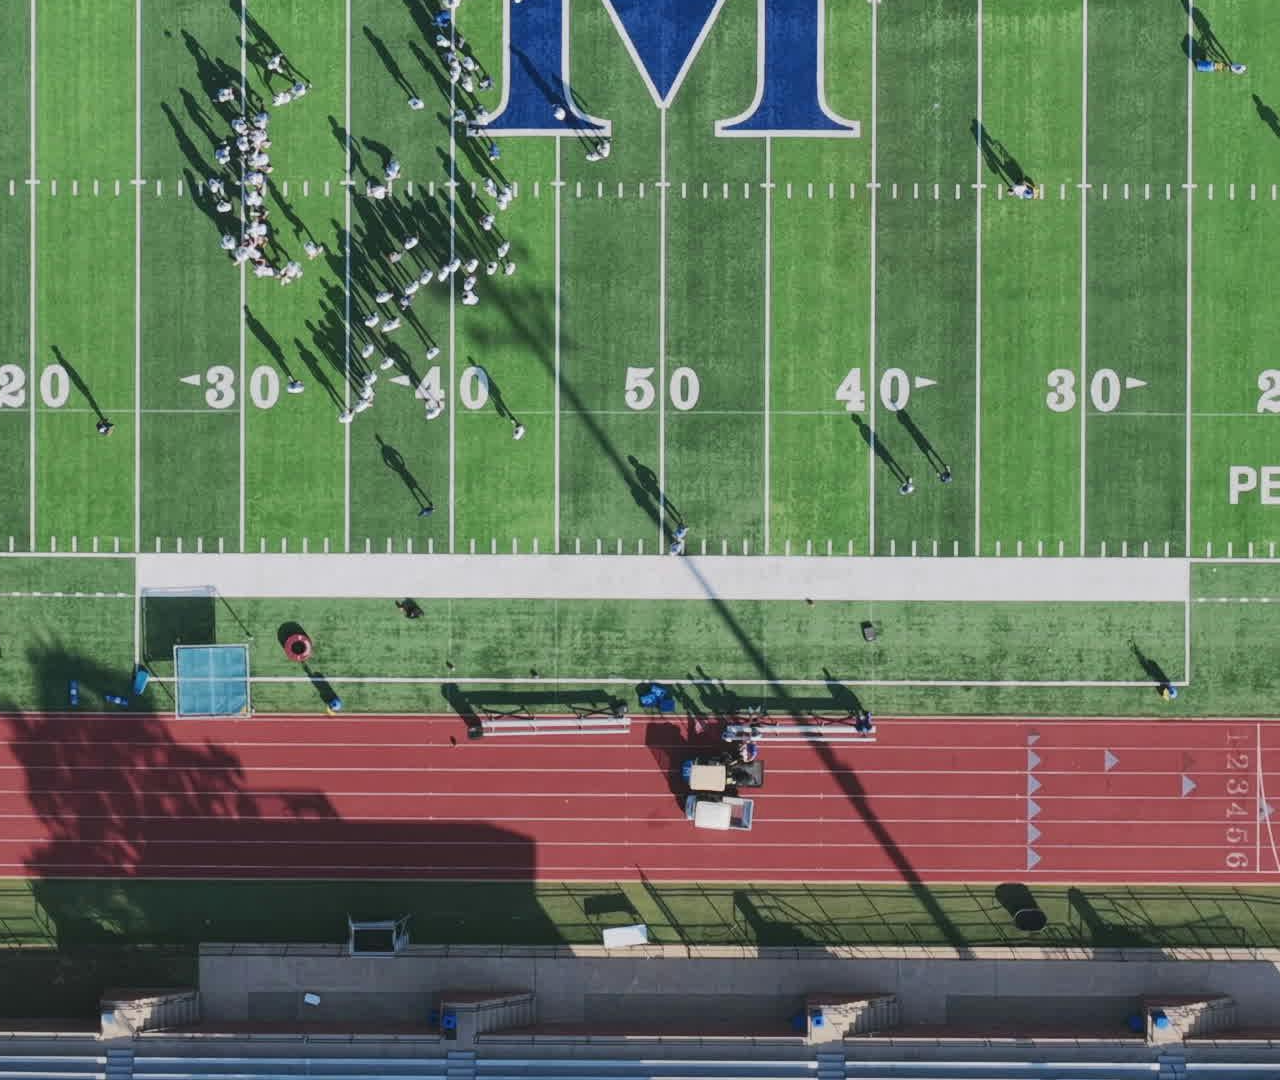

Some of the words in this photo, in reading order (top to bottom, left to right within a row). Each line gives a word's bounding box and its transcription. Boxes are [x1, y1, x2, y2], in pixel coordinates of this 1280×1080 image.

[205, 365, 280, 409] 30
[415, 366, 489, 410] 40
[625, 367, 700, 411] 50
[835, 367, 911, 411] 40
[1046, 368, 1121, 412] 30
[1226, 729, 1248, 744] 1
[1226, 753, 1248, 769] 2
[1226, 779, 1248, 794] 3
[1226, 802, 1248, 818] 4
[1226, 827, 1248, 843] 5
[1226, 852, 1248, 867] 6
